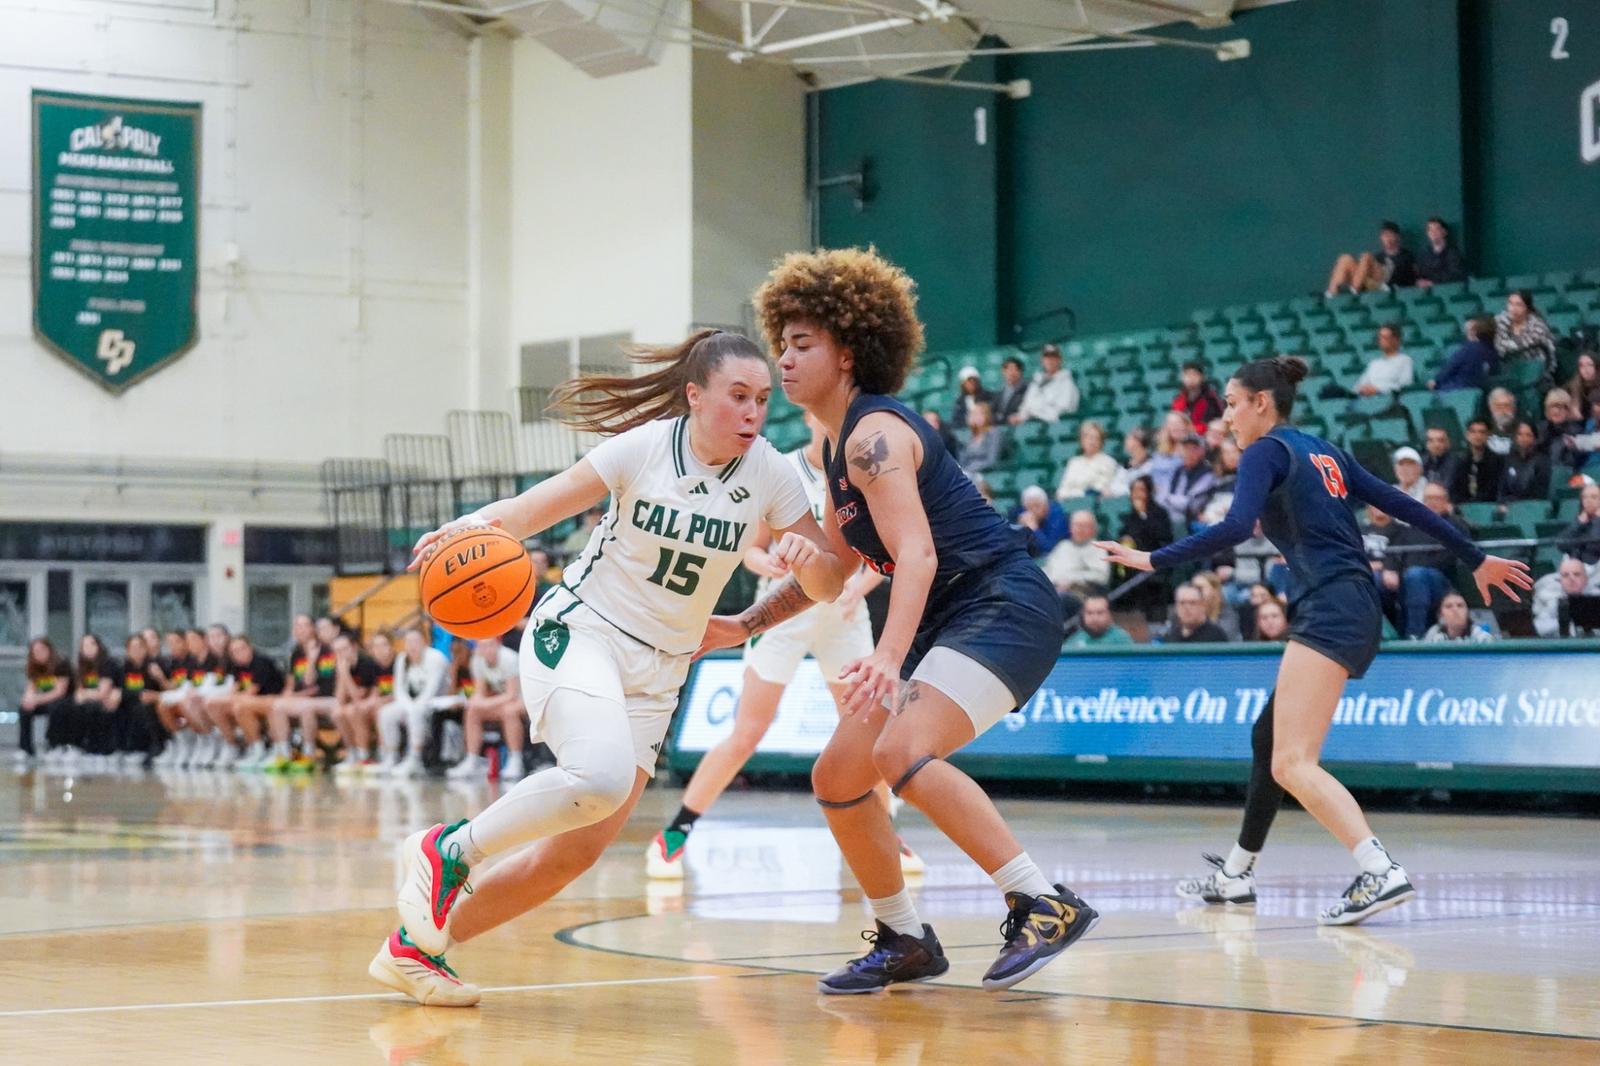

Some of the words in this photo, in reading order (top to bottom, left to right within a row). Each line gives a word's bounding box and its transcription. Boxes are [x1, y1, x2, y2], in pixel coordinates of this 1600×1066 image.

[1550, 17, 1570, 59] 2
[70, 124, 103, 152] CAL
[121, 125, 162, 156] POLY
[974, 107, 987, 145] 1
[1309, 452, 1348, 499] 13
[632, 499, 682, 540] CAL
[685, 513, 748, 552] POLY
[647, 546, 707, 596] 15
[1031, 688, 1179, 723] Excellence
[1184, 687, 1227, 723] On
[1332, 688, 1413, 726] ntral
[1417, 687, 1506, 726] Coast
[1512, 687, 1600, 727] Since
